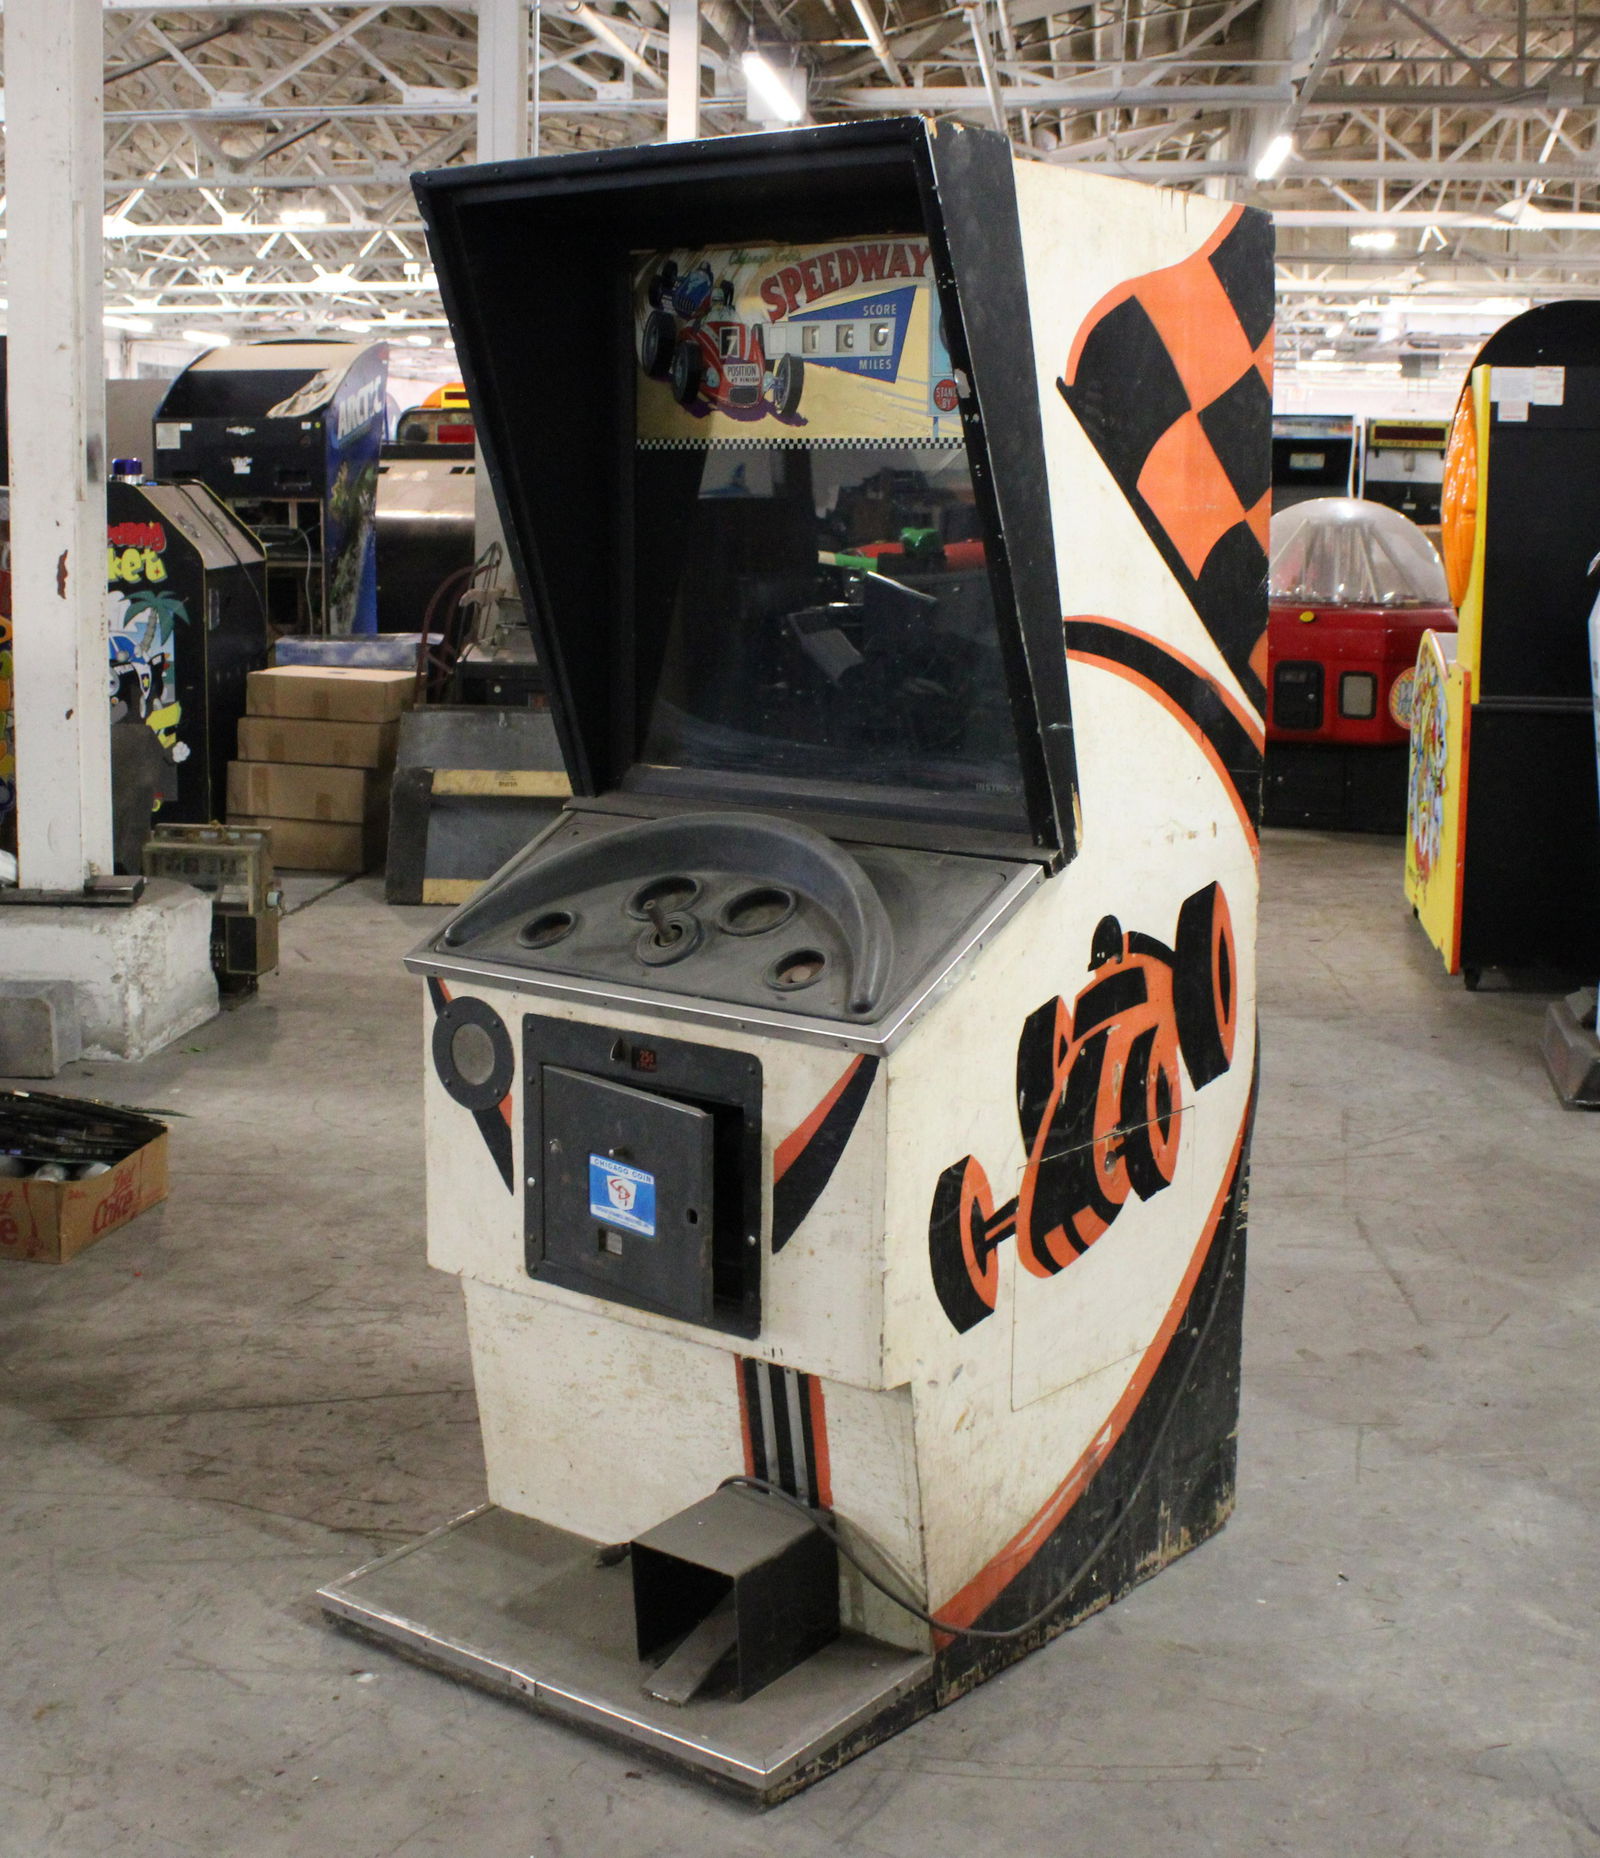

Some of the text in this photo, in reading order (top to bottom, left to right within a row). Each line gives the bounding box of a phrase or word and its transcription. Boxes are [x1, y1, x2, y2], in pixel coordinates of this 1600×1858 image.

[760, 244, 931, 324] SPEEDWAY
[863, 304, 896, 316] SCORE
[728, 366, 757, 376] POSITION
[859, 360, 892, 370] MILES
[337, 375, 381, 440] ARCTIC
[594, 1158, 652, 1183] CHICAGO COIN
